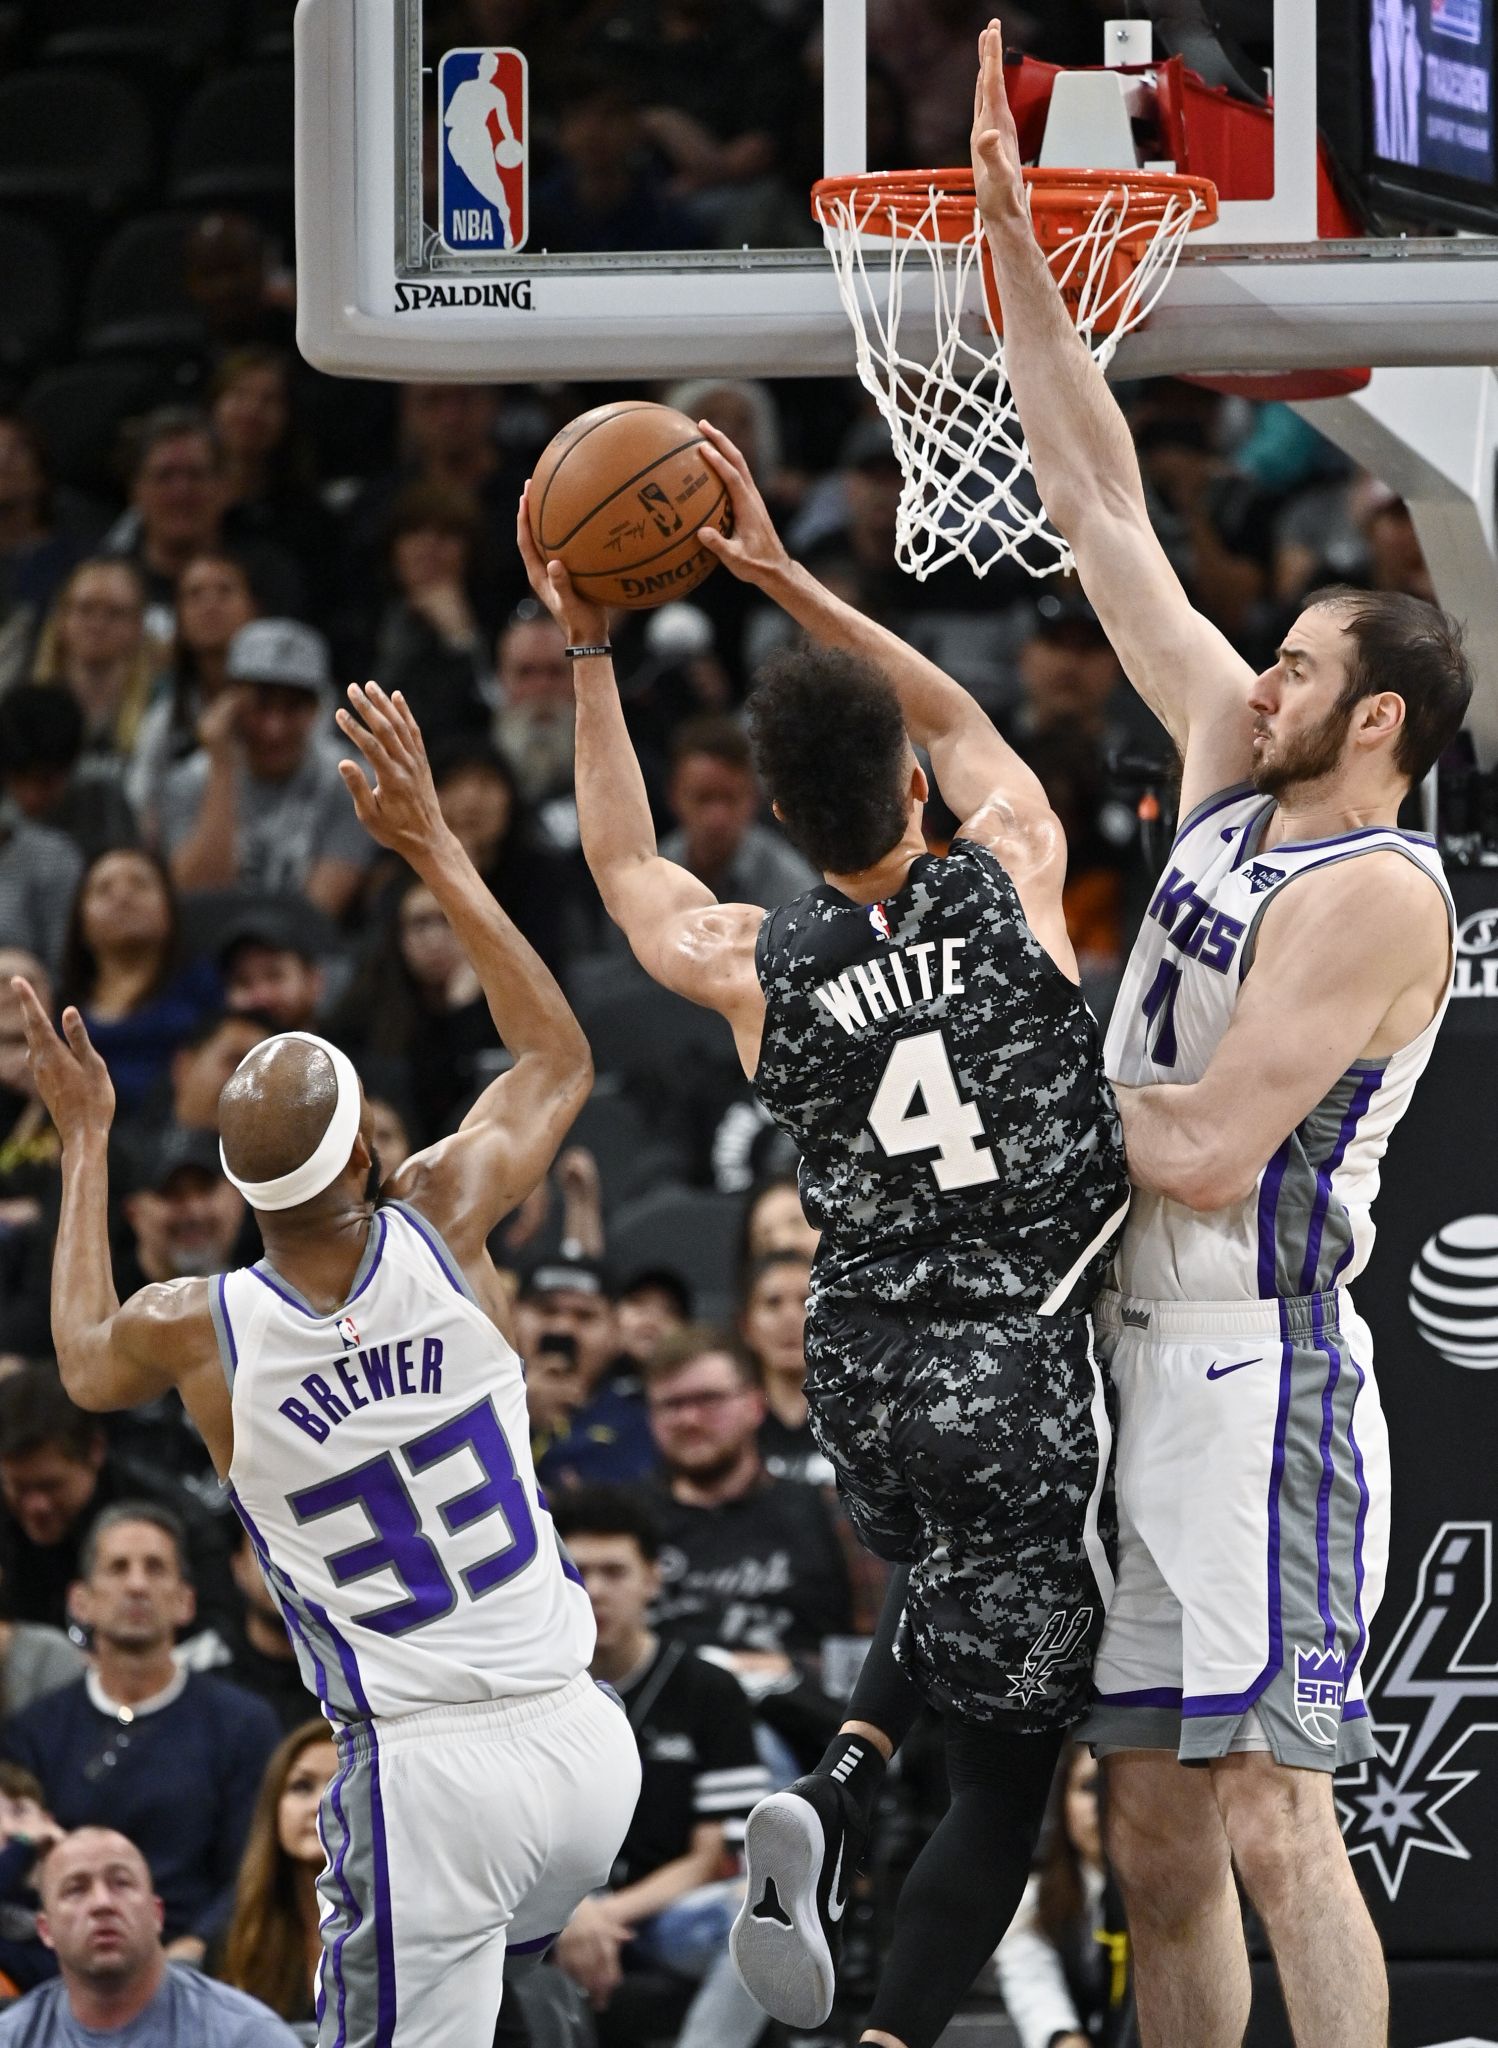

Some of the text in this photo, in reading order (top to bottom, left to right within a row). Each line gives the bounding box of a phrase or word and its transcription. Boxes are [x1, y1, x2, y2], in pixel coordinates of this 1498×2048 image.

[452, 209, 494, 241] NBA
[395, 280, 532, 312] SPALDING
[814, 938, 965, 1036] WHITE
[867, 1029, 1000, 1192] 4
[278, 1337, 444, 1445] BREWER
[284, 1392, 538, 1638] 33
